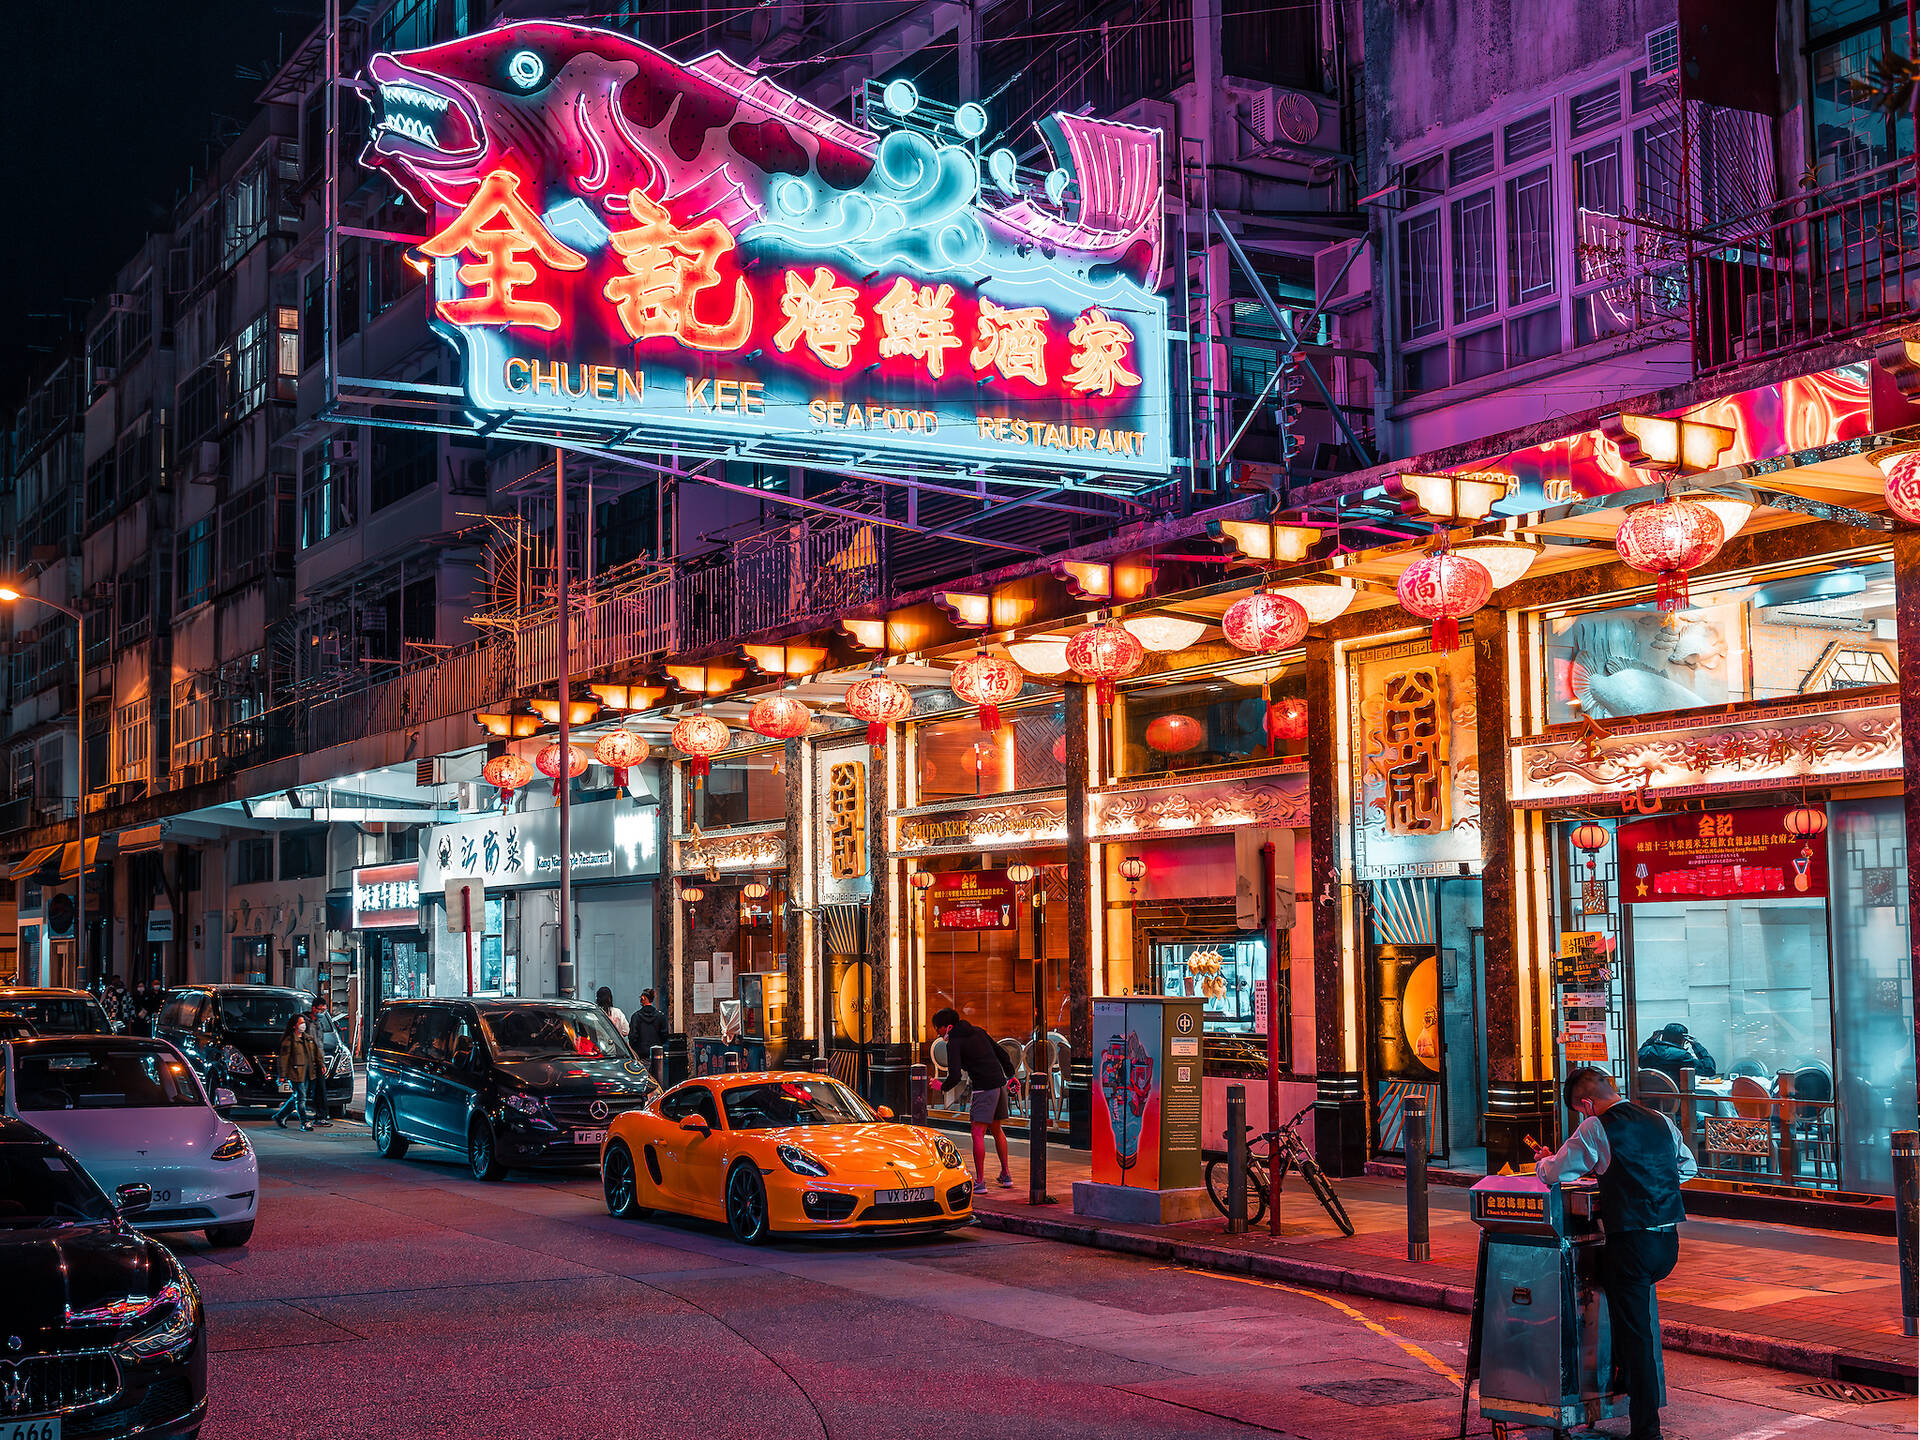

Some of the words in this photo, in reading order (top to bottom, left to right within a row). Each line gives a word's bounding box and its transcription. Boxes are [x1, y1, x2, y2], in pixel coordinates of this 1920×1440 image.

[503, 357, 645, 403] CHUEN
[686, 376, 766, 416] KEE
[809, 401, 938, 436] SEAFOOD
[977, 416, 1147, 457] RESTAURANT
[1406, 568, 1436, 600] 福
[984, 668, 1008, 692] 福
[578, 1133, 592, 1142] WF
[888, 1190, 900, 1202] VX
[903, 1188, 925, 1201] 8726
[13, 1422, 52, 1440] 666
